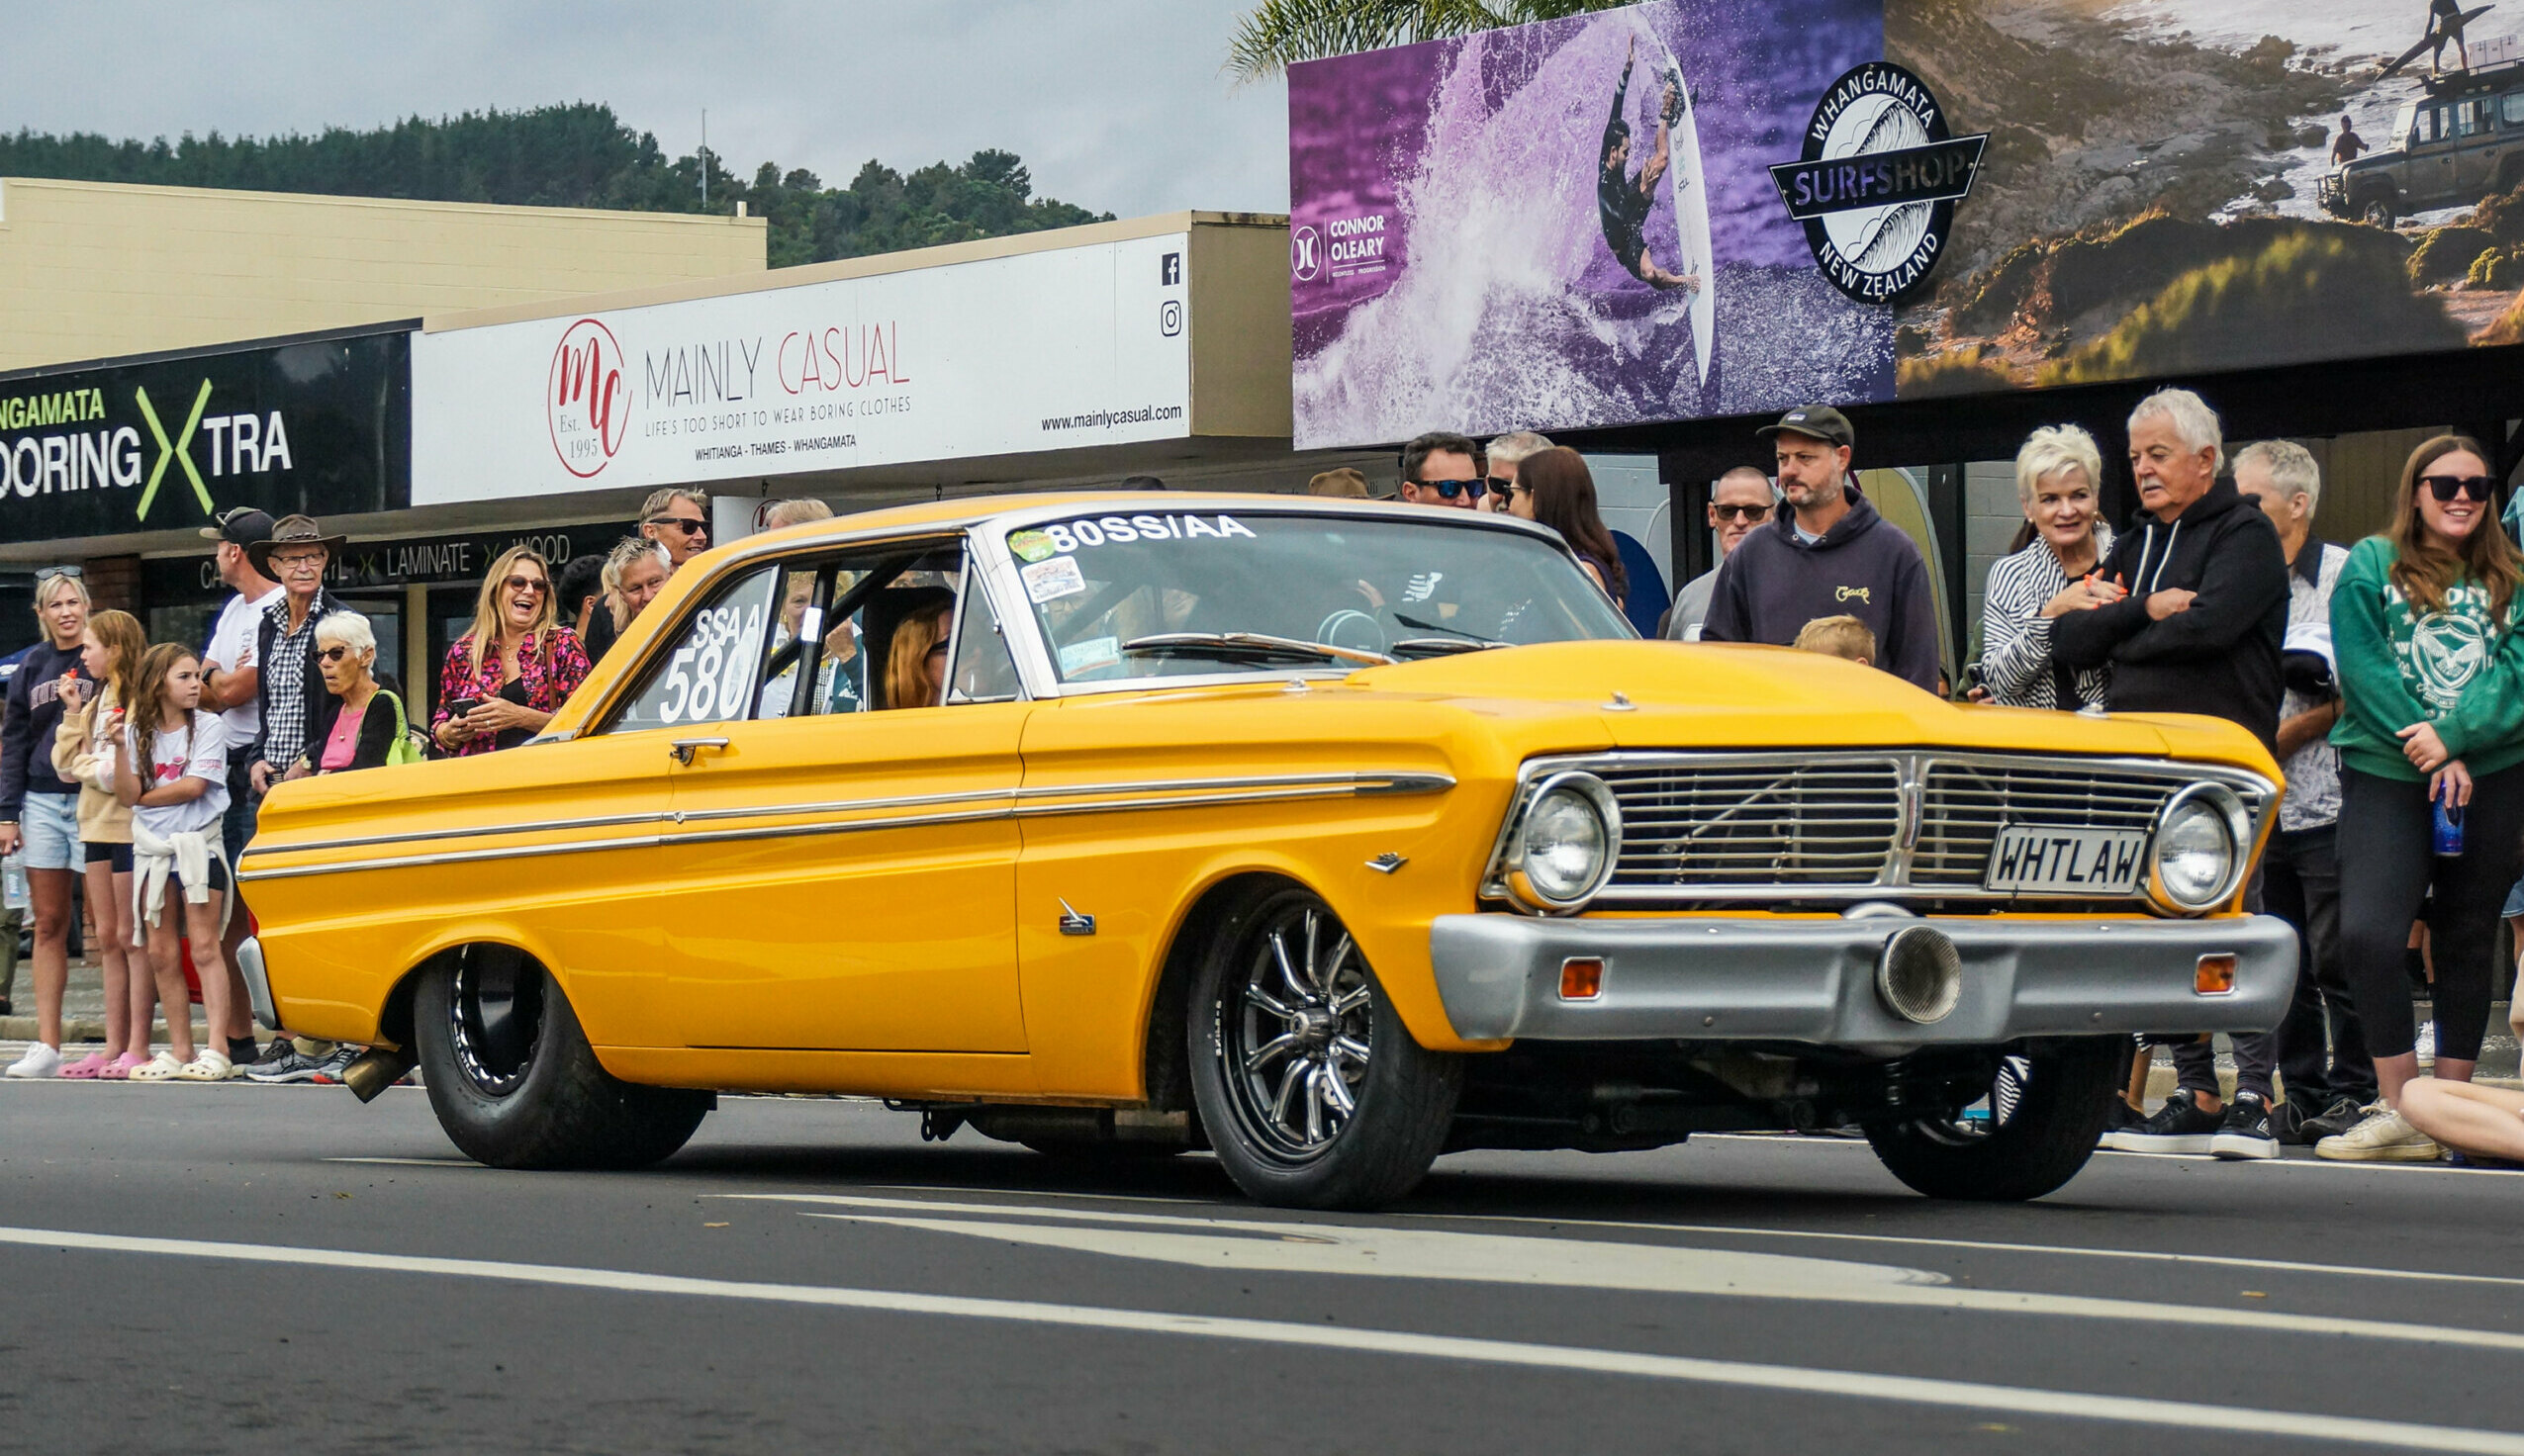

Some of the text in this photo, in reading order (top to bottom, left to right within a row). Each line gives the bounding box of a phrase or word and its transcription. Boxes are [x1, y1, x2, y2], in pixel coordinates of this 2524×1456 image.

[1812, 70, 1934, 141] WHANGAMATA
[1794, 149, 1966, 206] SURFSHOP
[1331, 215, 1384, 237] CONNOR
[1331, 236, 1384, 261] OLEARY
[1820, 232, 1937, 297] NEW ZEALAND
[646, 320, 910, 410] MAINLY CASUAL
[560, 414, 581, 433] Est.
[645, 397, 911, 437] LIFE'S TOO SHORT TO WEAR BORING CLOTHES
[1042, 405, 1181, 429] www.mainlycasual.com
[569, 438, 599, 459] 1995
[695, 445, 743, 461] WHITIANGA
[750, 441, 787, 456] THAMES
[794, 434, 857, 451] WHANGAMATA
[387, 542, 471, 577] LAMINATE
[660, 643, 754, 724] 580
[1998, 836, 2140, 883] WHTLAW
